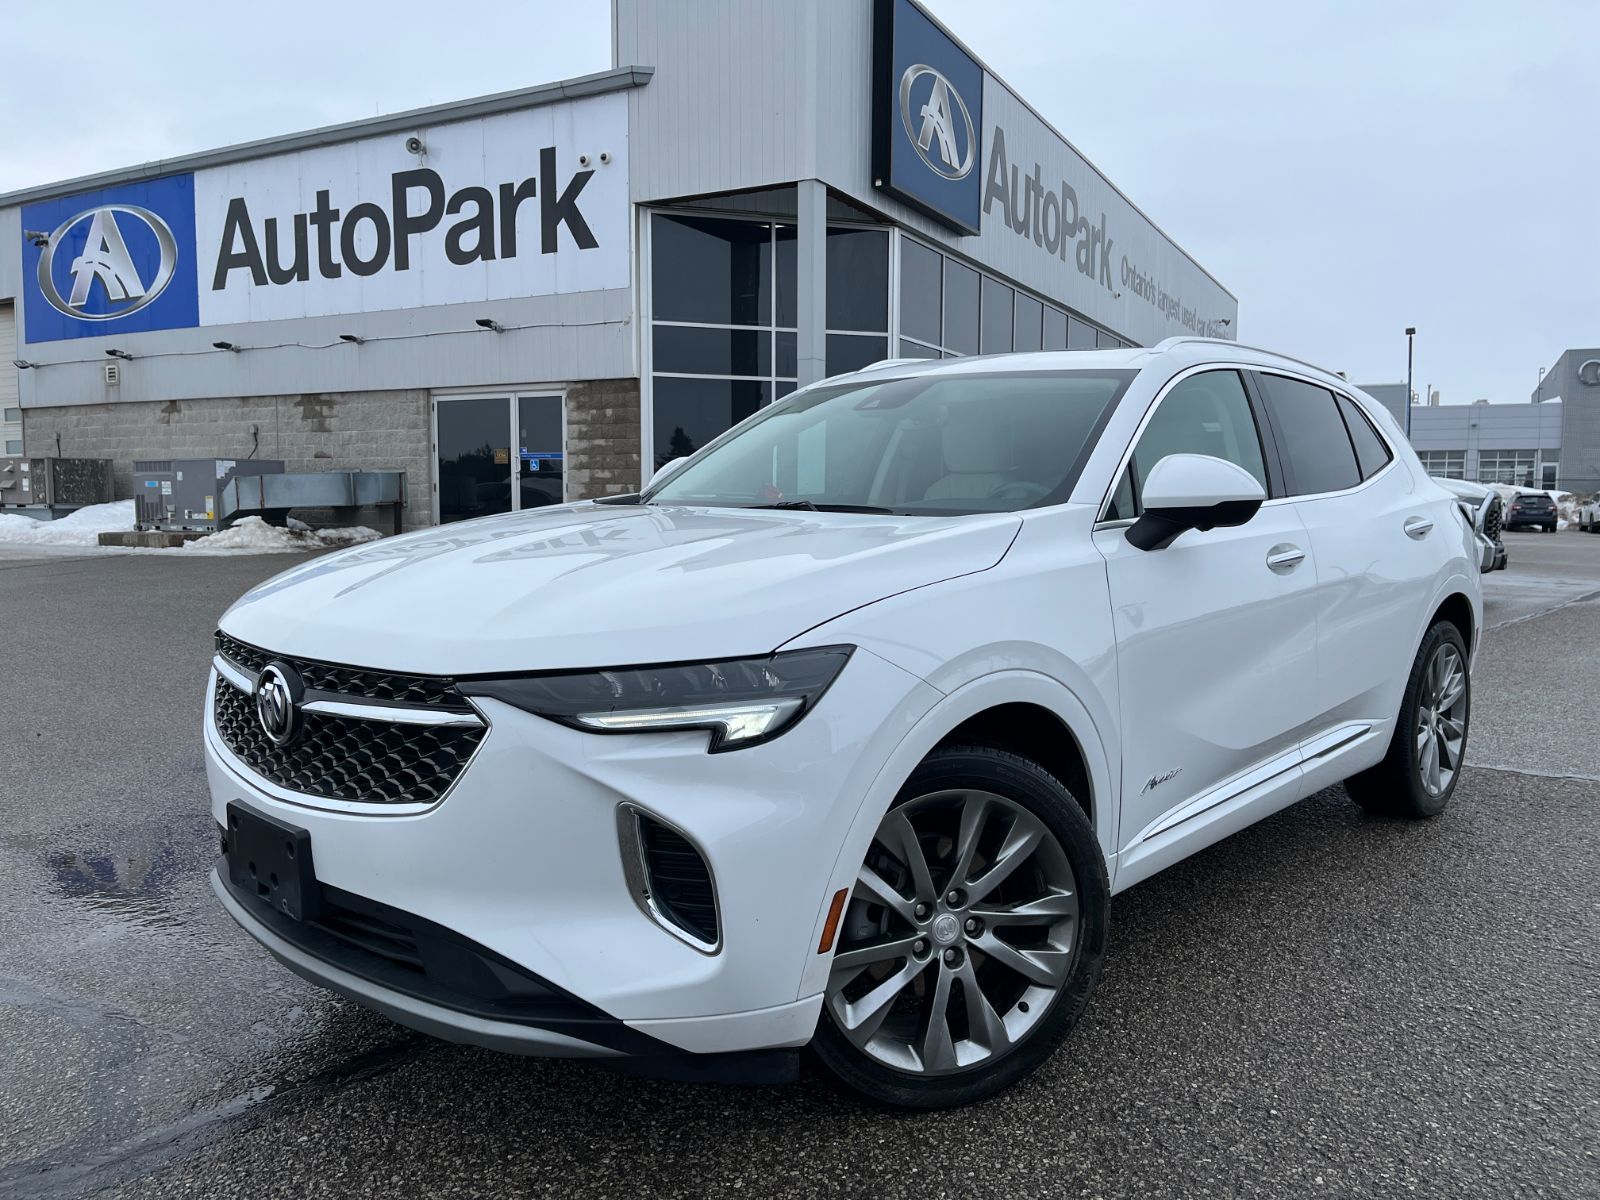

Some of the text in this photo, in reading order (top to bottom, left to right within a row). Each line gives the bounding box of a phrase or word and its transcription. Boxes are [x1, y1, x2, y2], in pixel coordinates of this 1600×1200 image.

[212, 146, 599, 291] AutoPark
[983, 125, 1113, 291] AutoPark
[1121, 255, 1156, 307] Ontario's
[1157, 280, 1181, 321] largest
